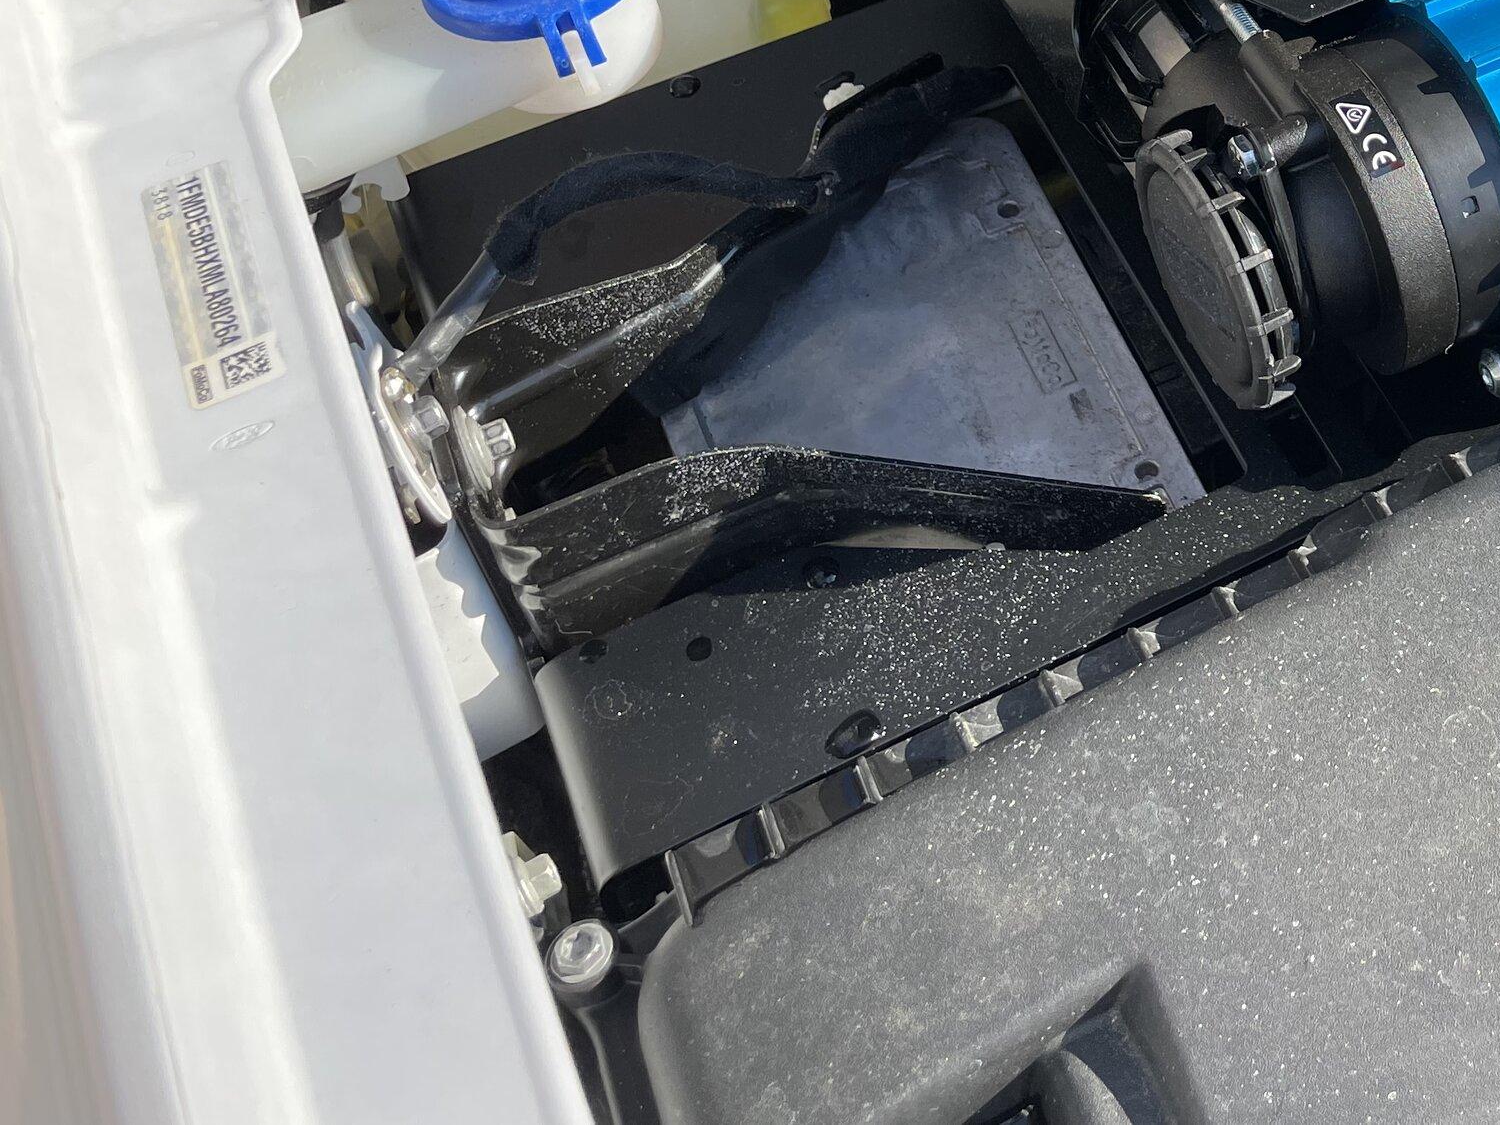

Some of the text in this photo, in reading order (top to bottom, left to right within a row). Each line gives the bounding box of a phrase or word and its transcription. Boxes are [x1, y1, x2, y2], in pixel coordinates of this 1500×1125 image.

[151, 187, 173, 221] 3818
[176, 176, 242, 348] 1FMDE5BHXMLA80264
[192, 365, 213, 404] FoMoCo
